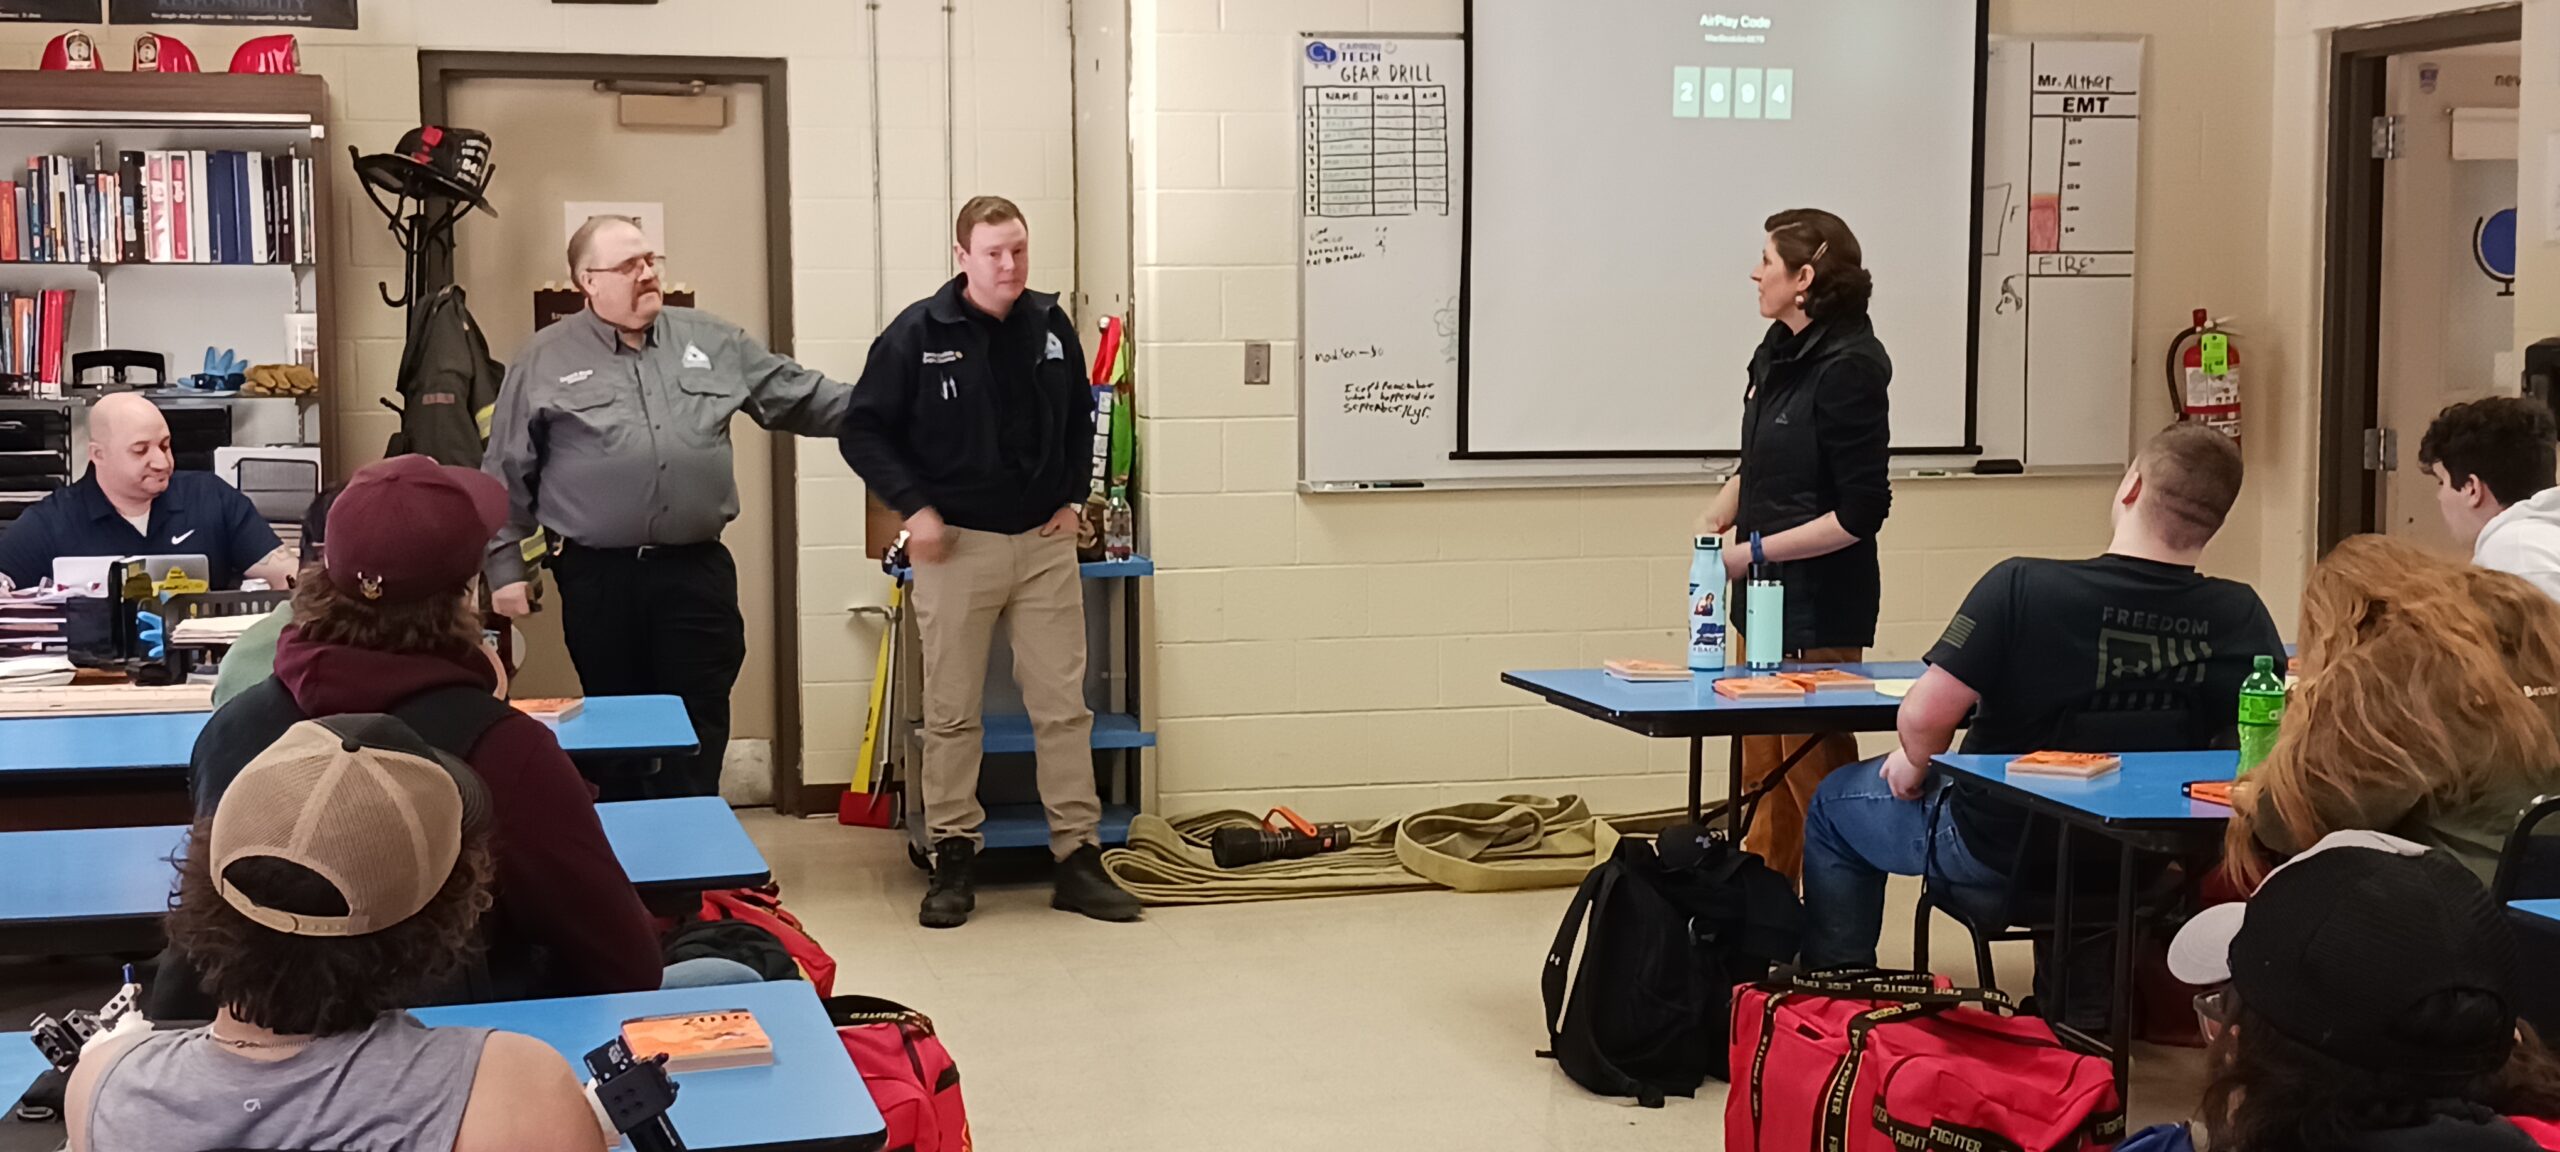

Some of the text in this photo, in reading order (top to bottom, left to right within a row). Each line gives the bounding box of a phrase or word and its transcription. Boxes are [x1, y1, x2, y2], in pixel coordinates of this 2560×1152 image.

[1700, 14, 1771, 29] AirPlay Code
[1341, 52, 1381, 62] TECH
[1340, 63, 1432, 83] GEAR DRILL
[2038, 74, 2061, 87] Mr.
[1325, 92, 1359, 101] NAME
[2062, 96, 2109, 113] EMT
[2102, 606, 2209, 635] FREEDOM
[1895, 1130, 1928, 1151] FIGHT
